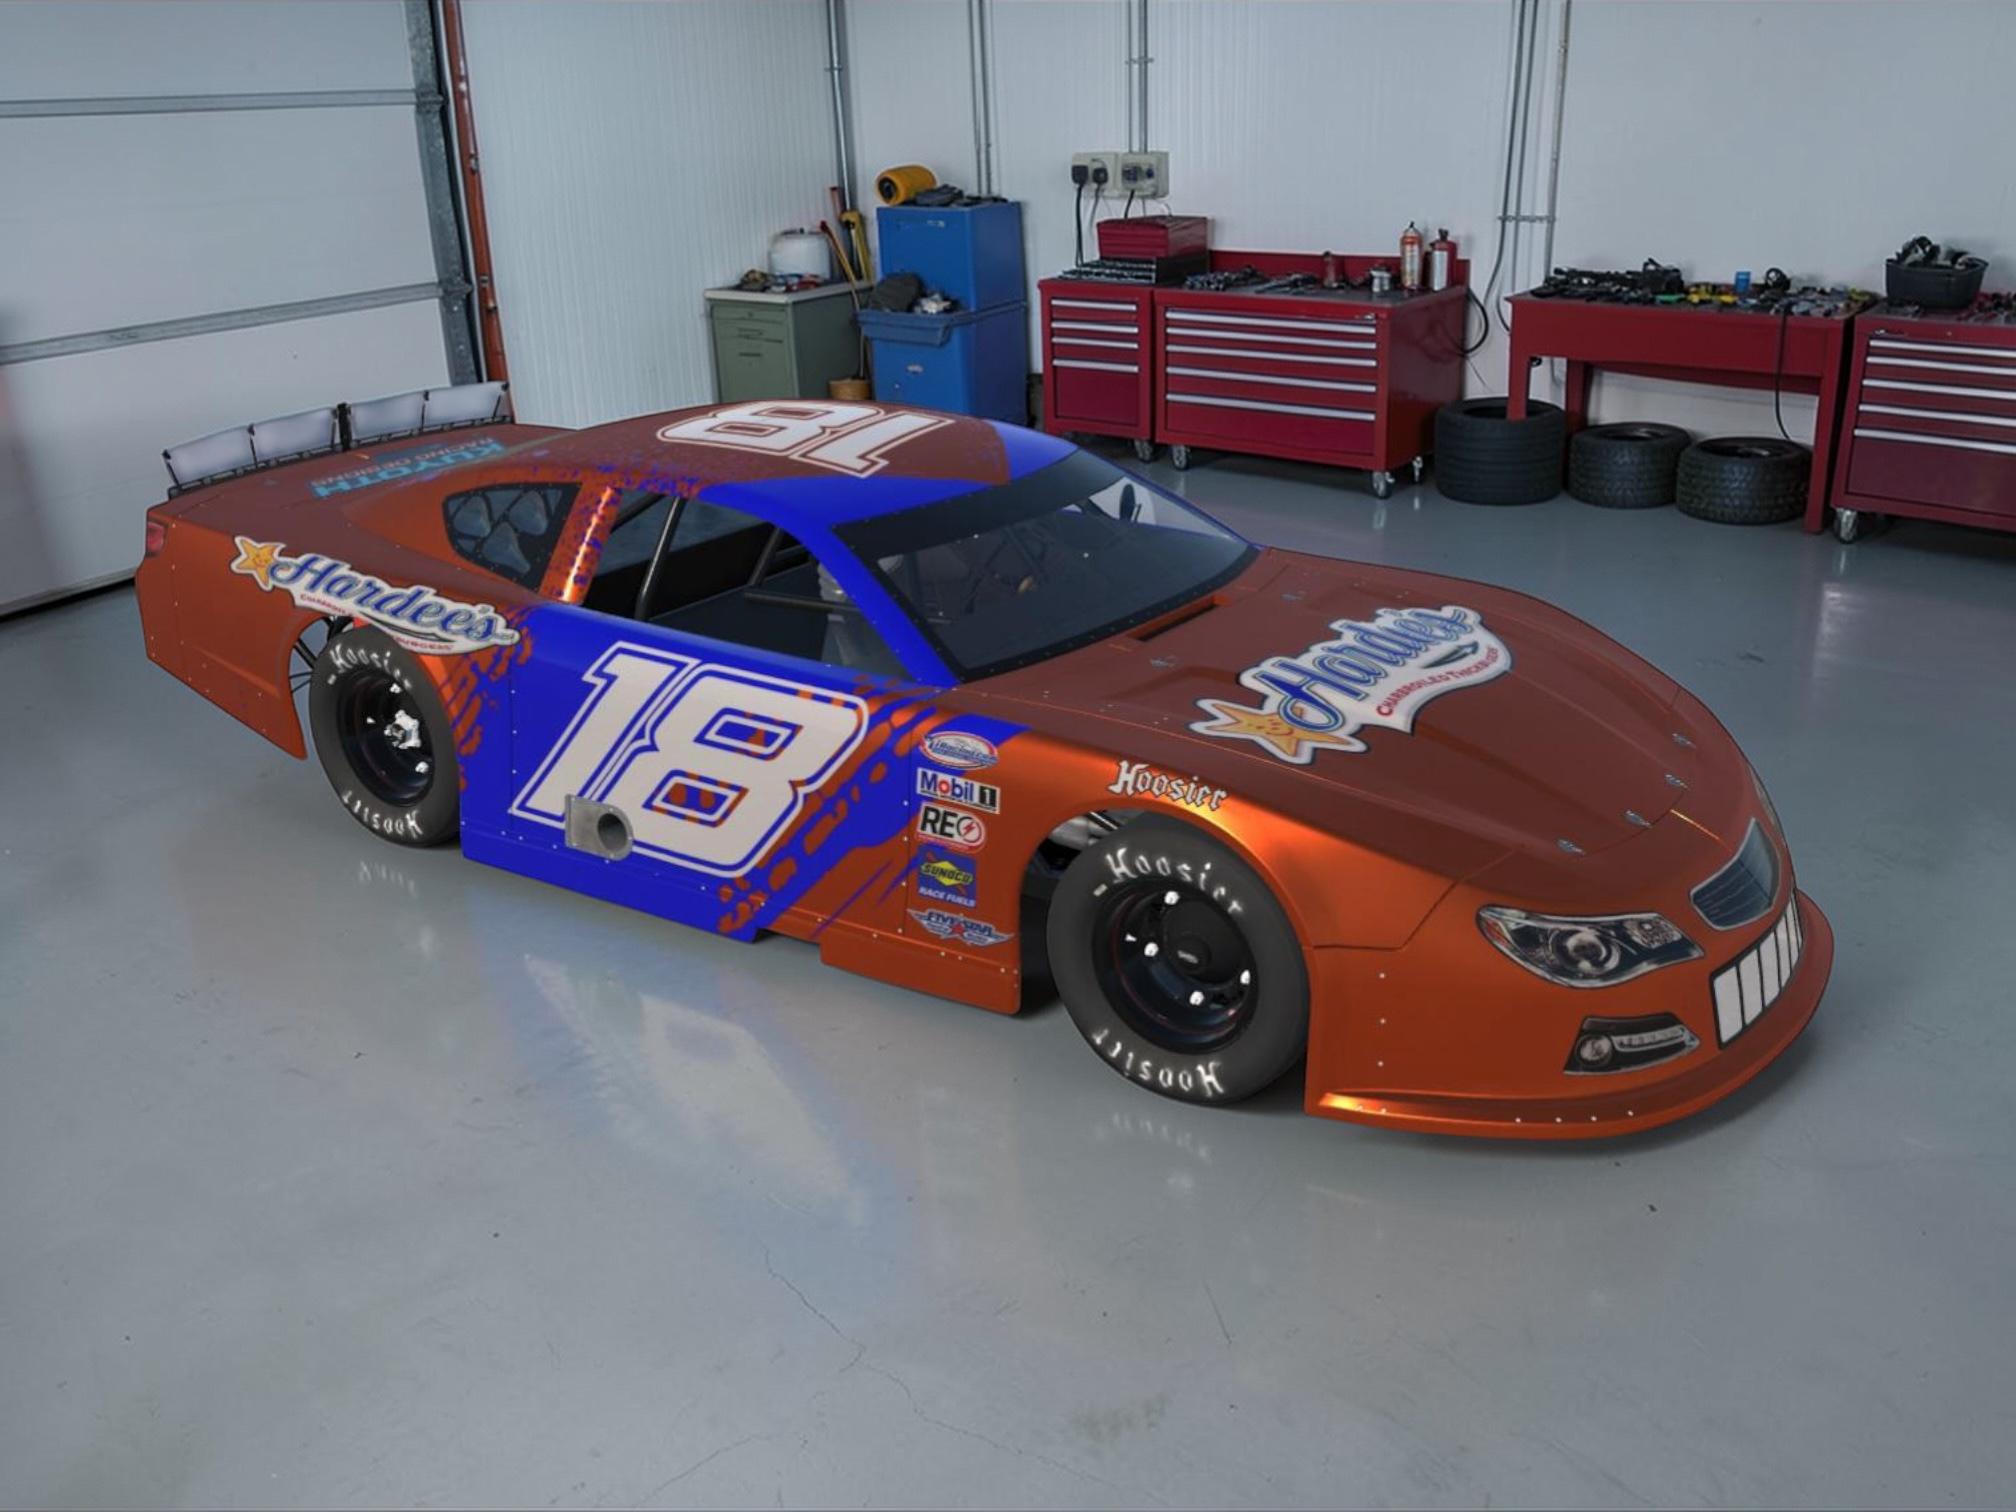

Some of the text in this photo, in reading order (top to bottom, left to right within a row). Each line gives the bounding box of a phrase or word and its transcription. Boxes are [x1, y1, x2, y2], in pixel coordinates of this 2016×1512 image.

[656, 399, 955, 478] 18
[270, 554, 499, 641] Hardee's
[1253, 607, 1475, 732] Hardee's
[508, 640, 870, 878] 18
[920, 770, 974, 802] Mobil
[1108, 759, 1228, 811] Hoosier
[919, 886, 977, 908] RACE FUELS
[924, 863, 972, 883] SUNOCO
[1105, 847, 1244, 913] Hoosier
[1091, 1027, 1225, 1098] Hoosier
